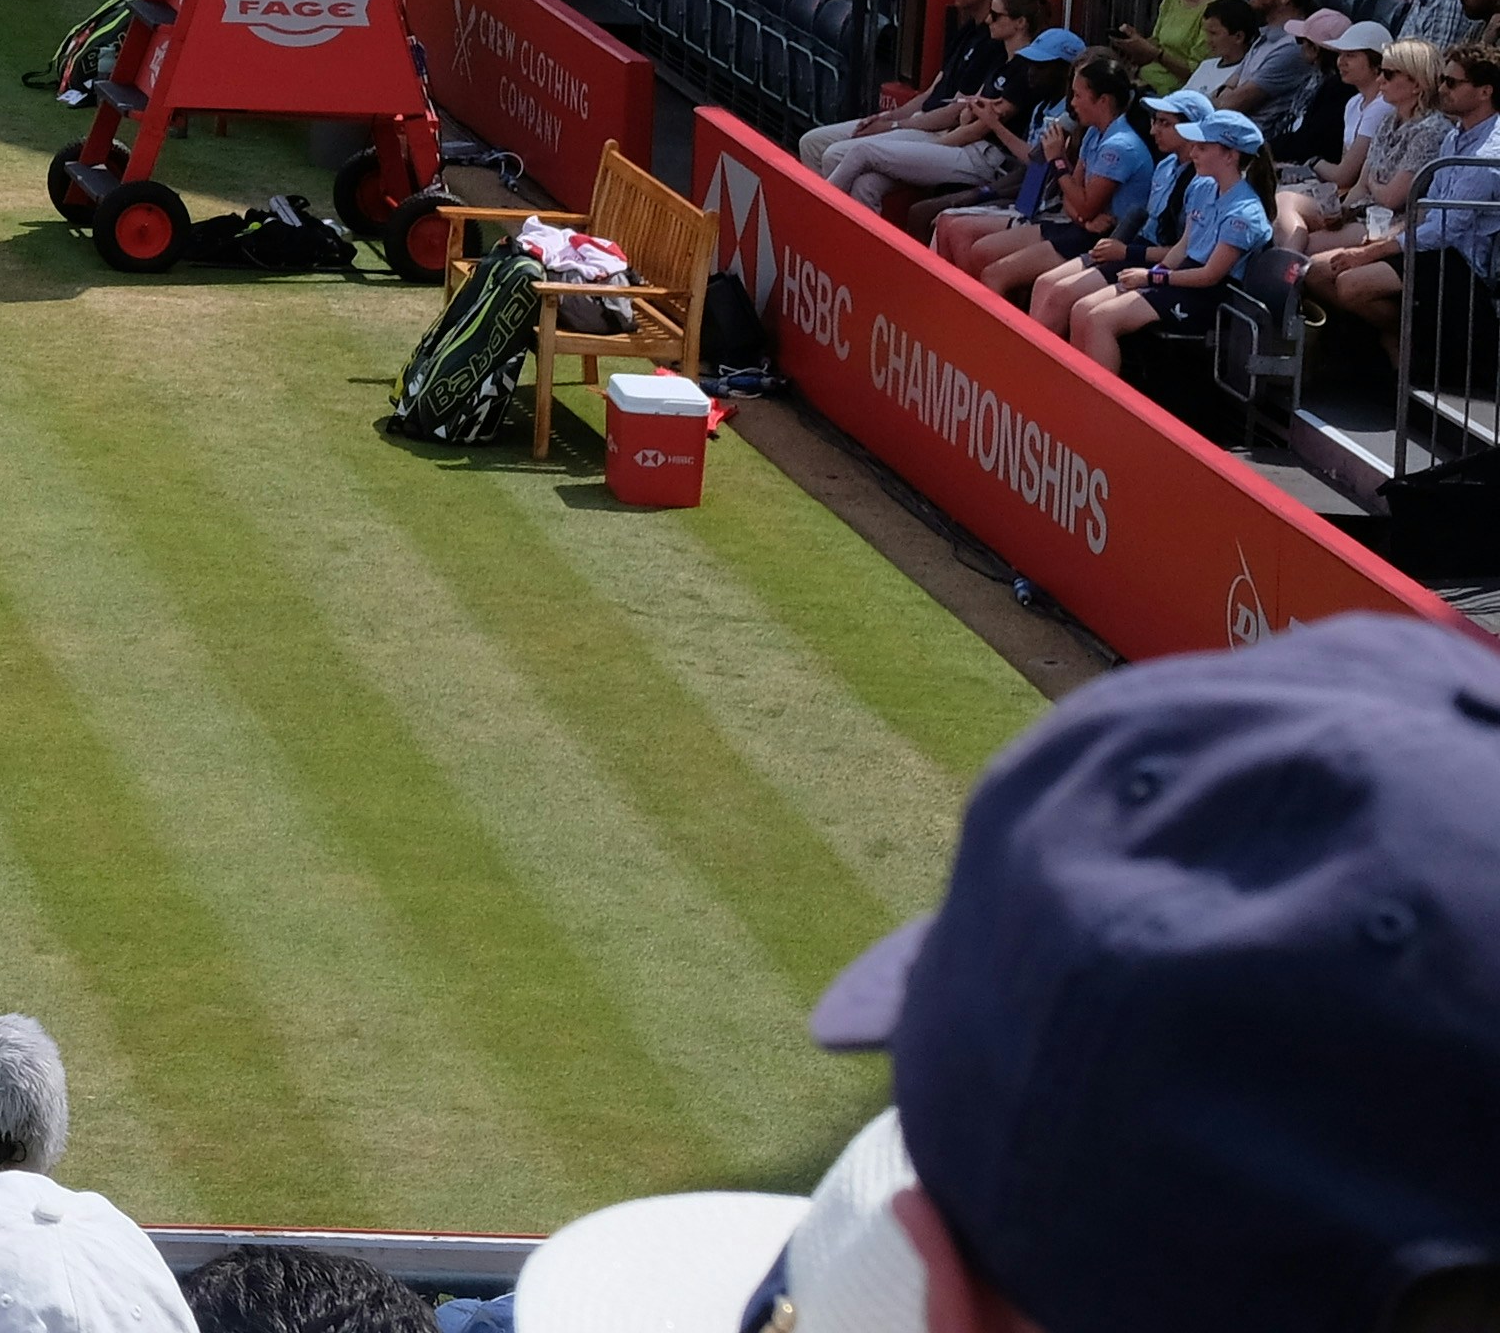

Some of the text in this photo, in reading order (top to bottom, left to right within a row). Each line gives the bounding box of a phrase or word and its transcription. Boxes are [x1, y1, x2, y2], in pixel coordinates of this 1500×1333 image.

[238, 0, 356, 18] FAGE
[480, 10, 516, 65] CREW
[520, 40, 589, 120] CLOTHING
[500, 76, 562, 153] COMPANY
[783, 245, 1111, 555] HSBC CHAMPIONSHIPS
